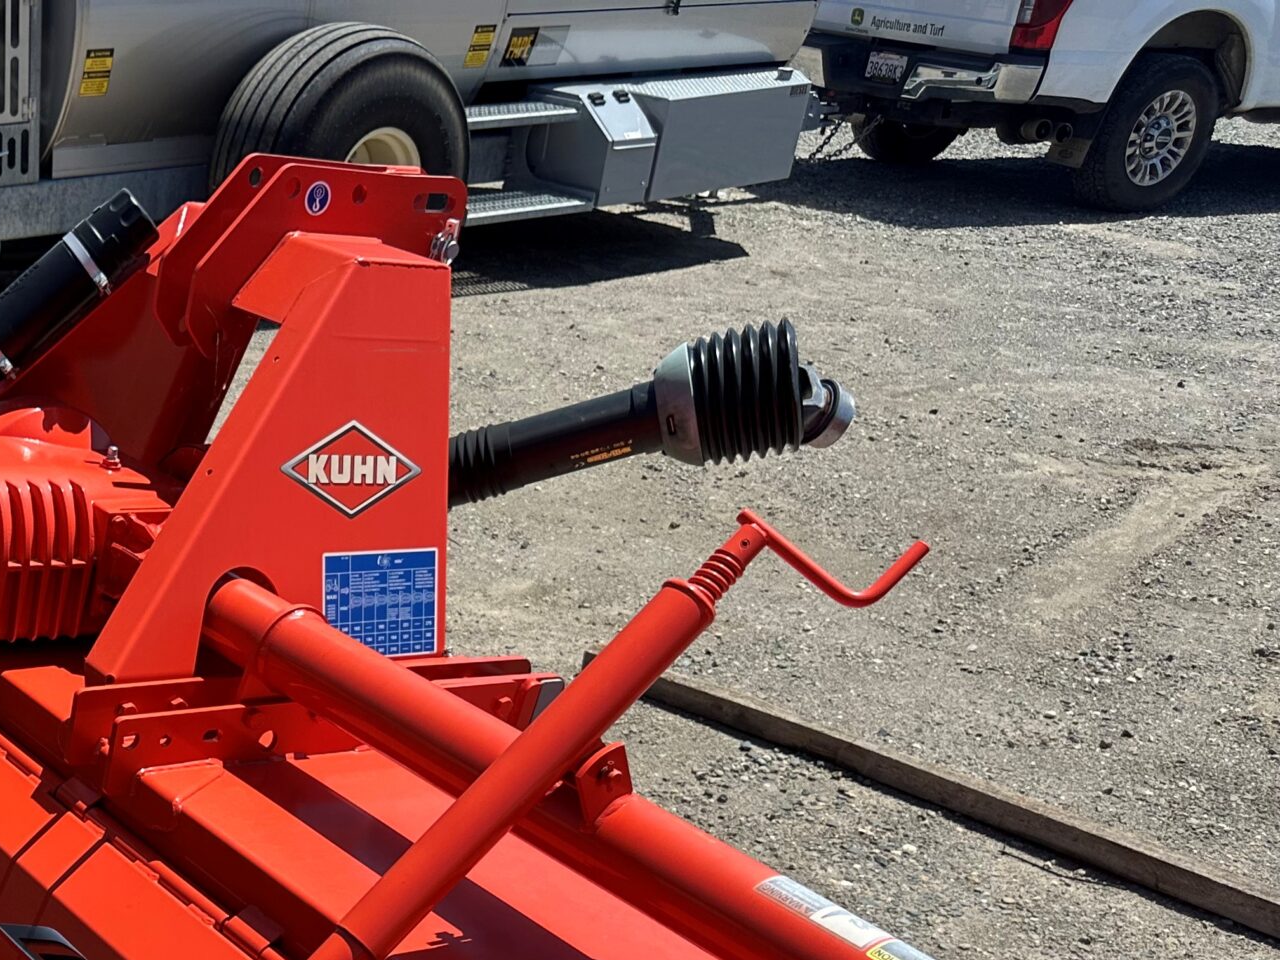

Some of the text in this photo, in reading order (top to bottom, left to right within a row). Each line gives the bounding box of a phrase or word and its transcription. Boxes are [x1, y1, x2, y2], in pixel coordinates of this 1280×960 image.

[871, 15, 911, 33] Agriculture
[912, 22, 927, 35] and
[929, 23, 945, 37] Turf
[308, 453, 398, 485] KUHN
[761, 883, 803, 911] WARNING
